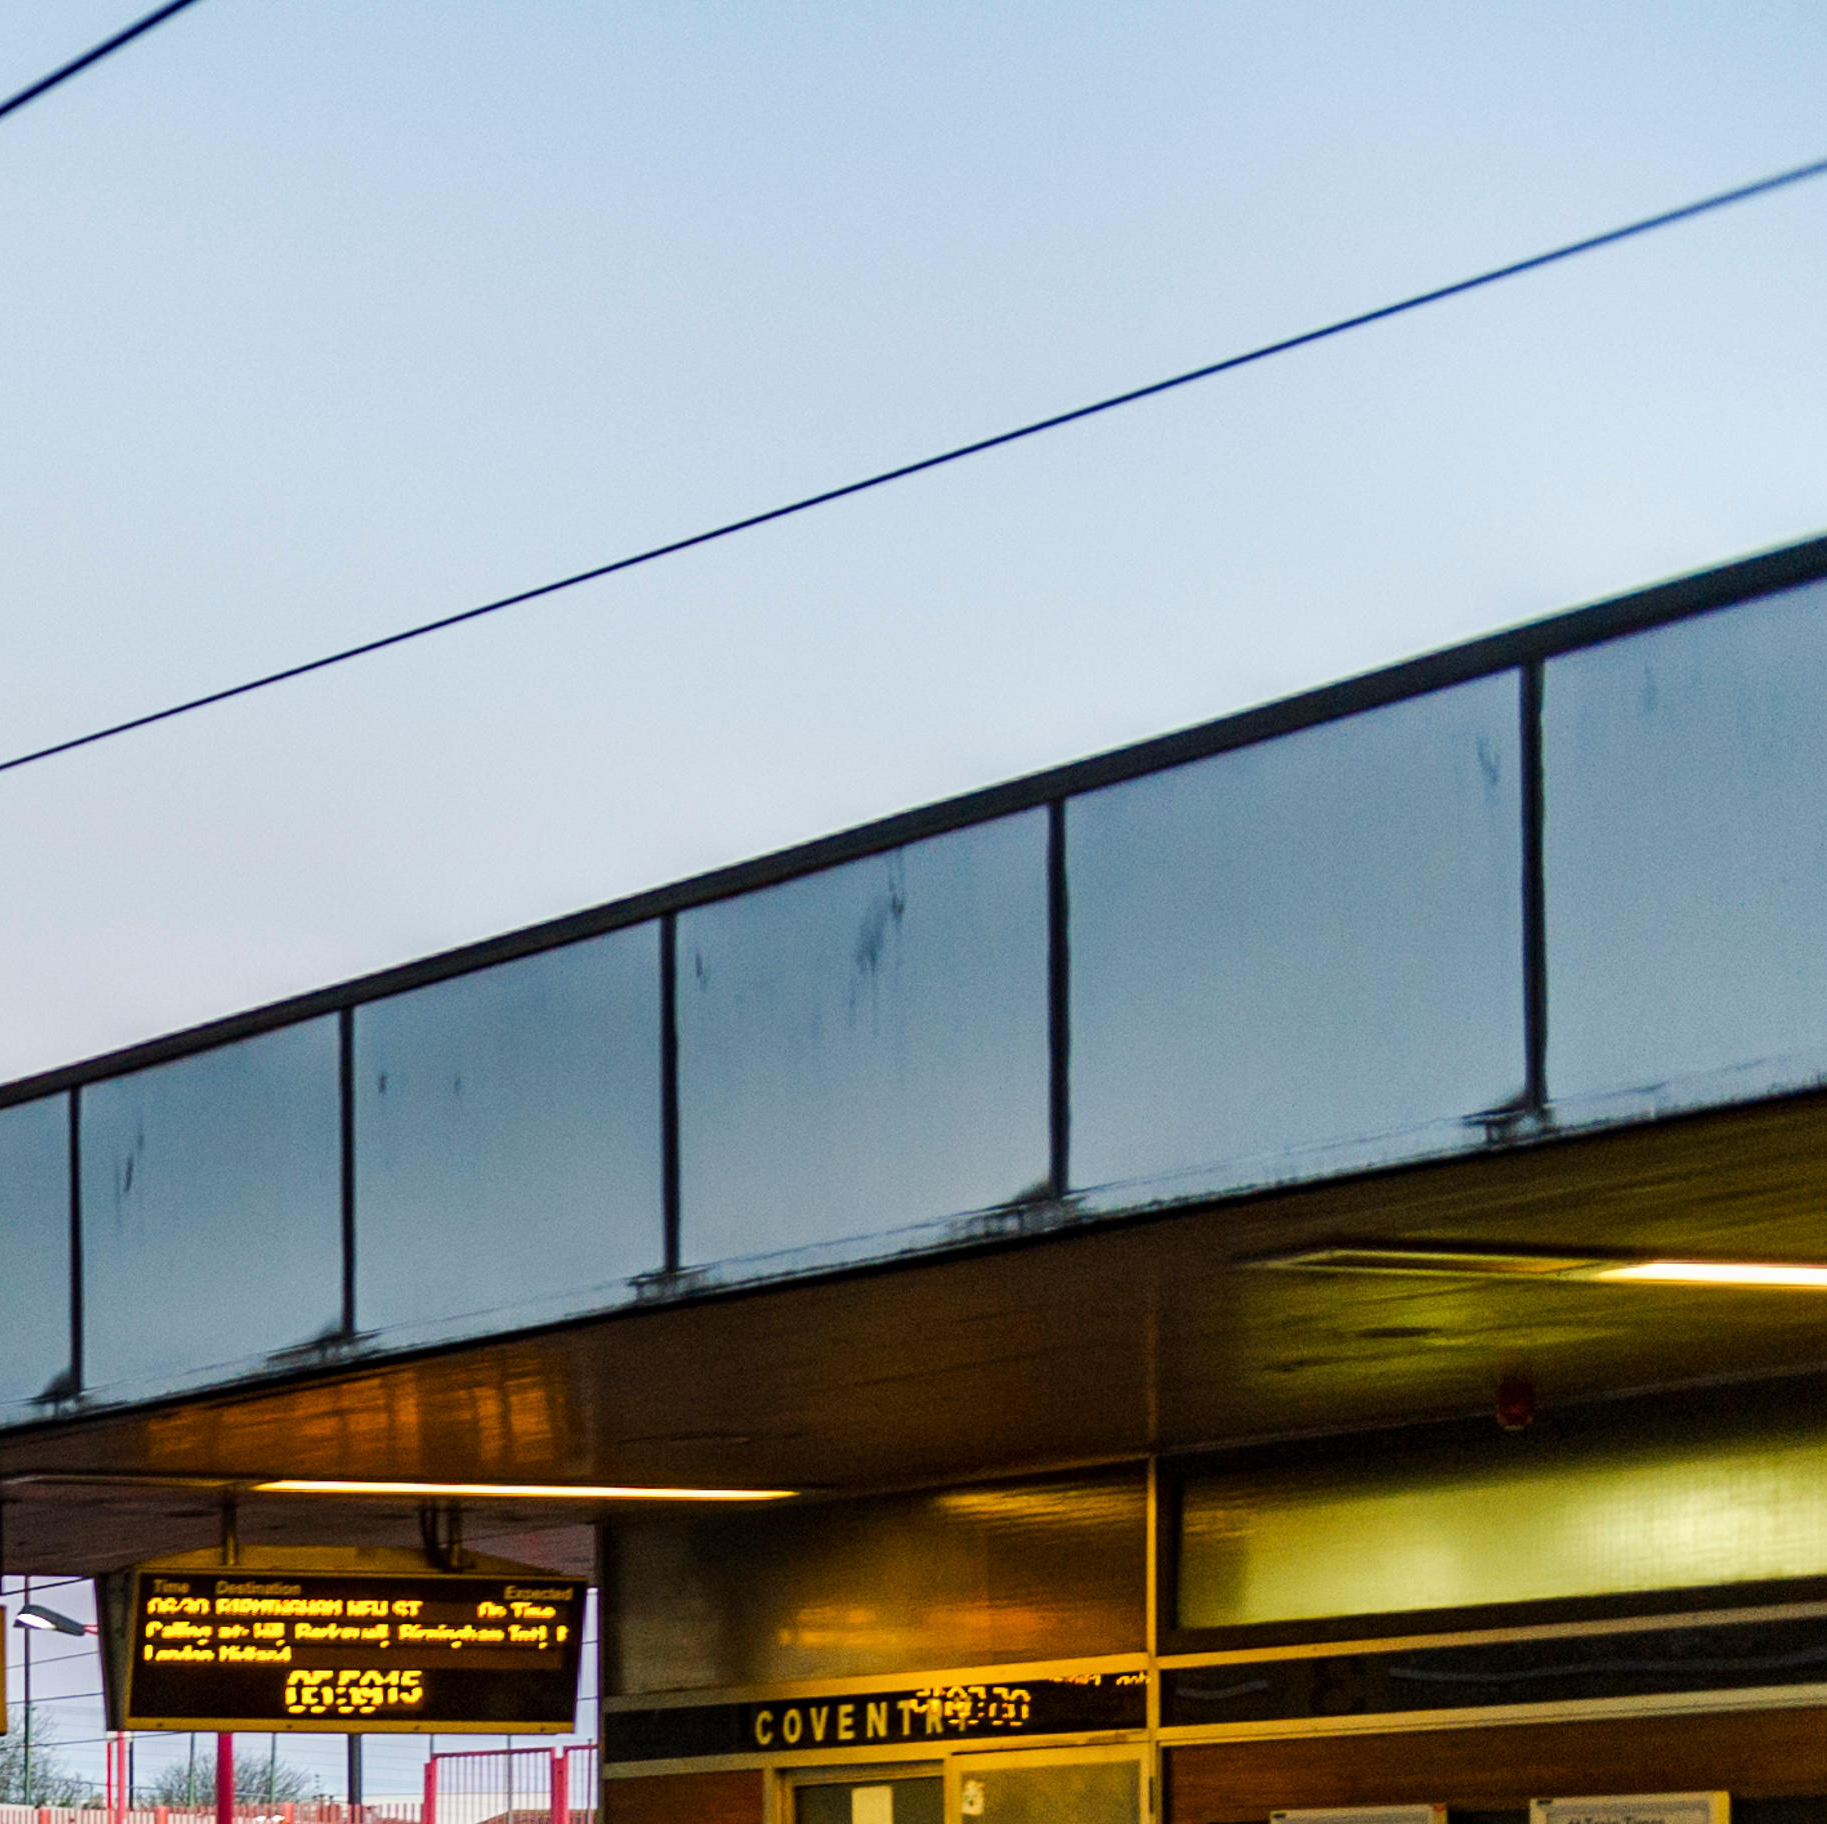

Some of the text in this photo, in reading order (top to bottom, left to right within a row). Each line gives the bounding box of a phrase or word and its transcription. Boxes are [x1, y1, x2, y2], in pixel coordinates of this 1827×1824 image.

[153, 1580, 574, 1600] Time Destination Expected
[218, 1645, 292, 1662] Midland
